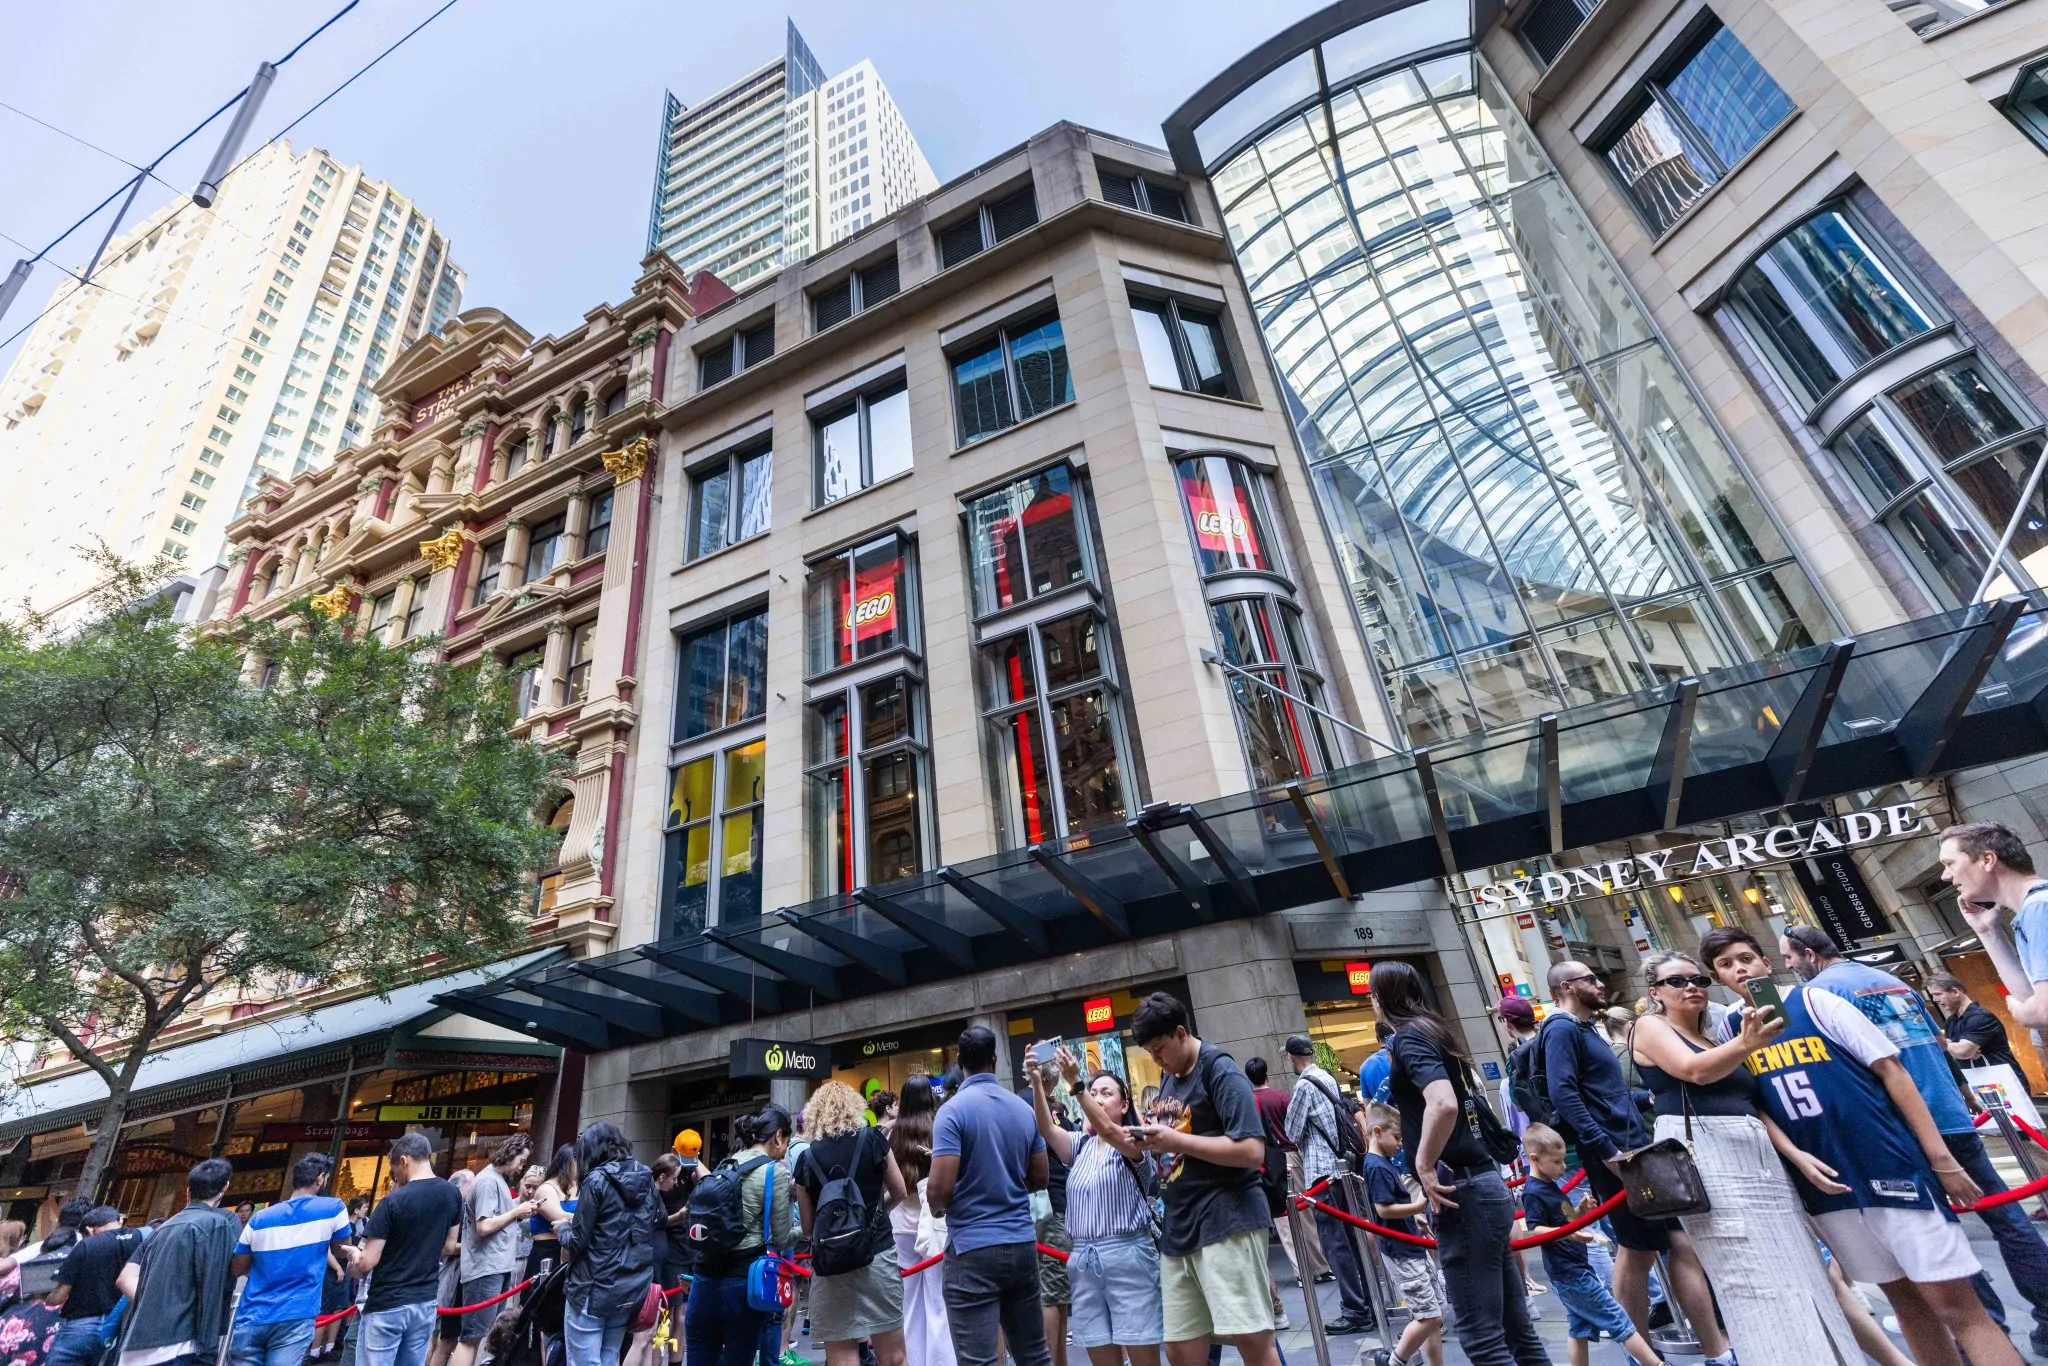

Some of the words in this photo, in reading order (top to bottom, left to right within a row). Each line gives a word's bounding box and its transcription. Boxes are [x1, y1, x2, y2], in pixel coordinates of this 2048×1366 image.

[438, 380, 464, 399] THE
[416, 383, 475, 423] STRAN
[1198, 512, 1247, 537] LEGO
[1480, 850, 1673, 914] SYDNEY
[1690, 802, 1922, 875] ARCADE
[1832, 862, 1854, 892] STUDIO
[1820, 895, 1838, 921] STUDIO
[1849, 893, 1874, 929] GENESIS
[1353, 927, 1374, 940] 189
[1834, 922, 1854, 952] GENESIS
[1350, 971, 1370, 985] LEGO
[1087, 1006, 1111, 1022] LEGO
[876, 1040, 899, 1052] Metro
[785, 1050, 816, 1070] Metro
[1771, 1071, 1823, 1120] 15
[418, 1107, 442, 1119] JB
[305, 1125, 369, 1137] Stranbags
